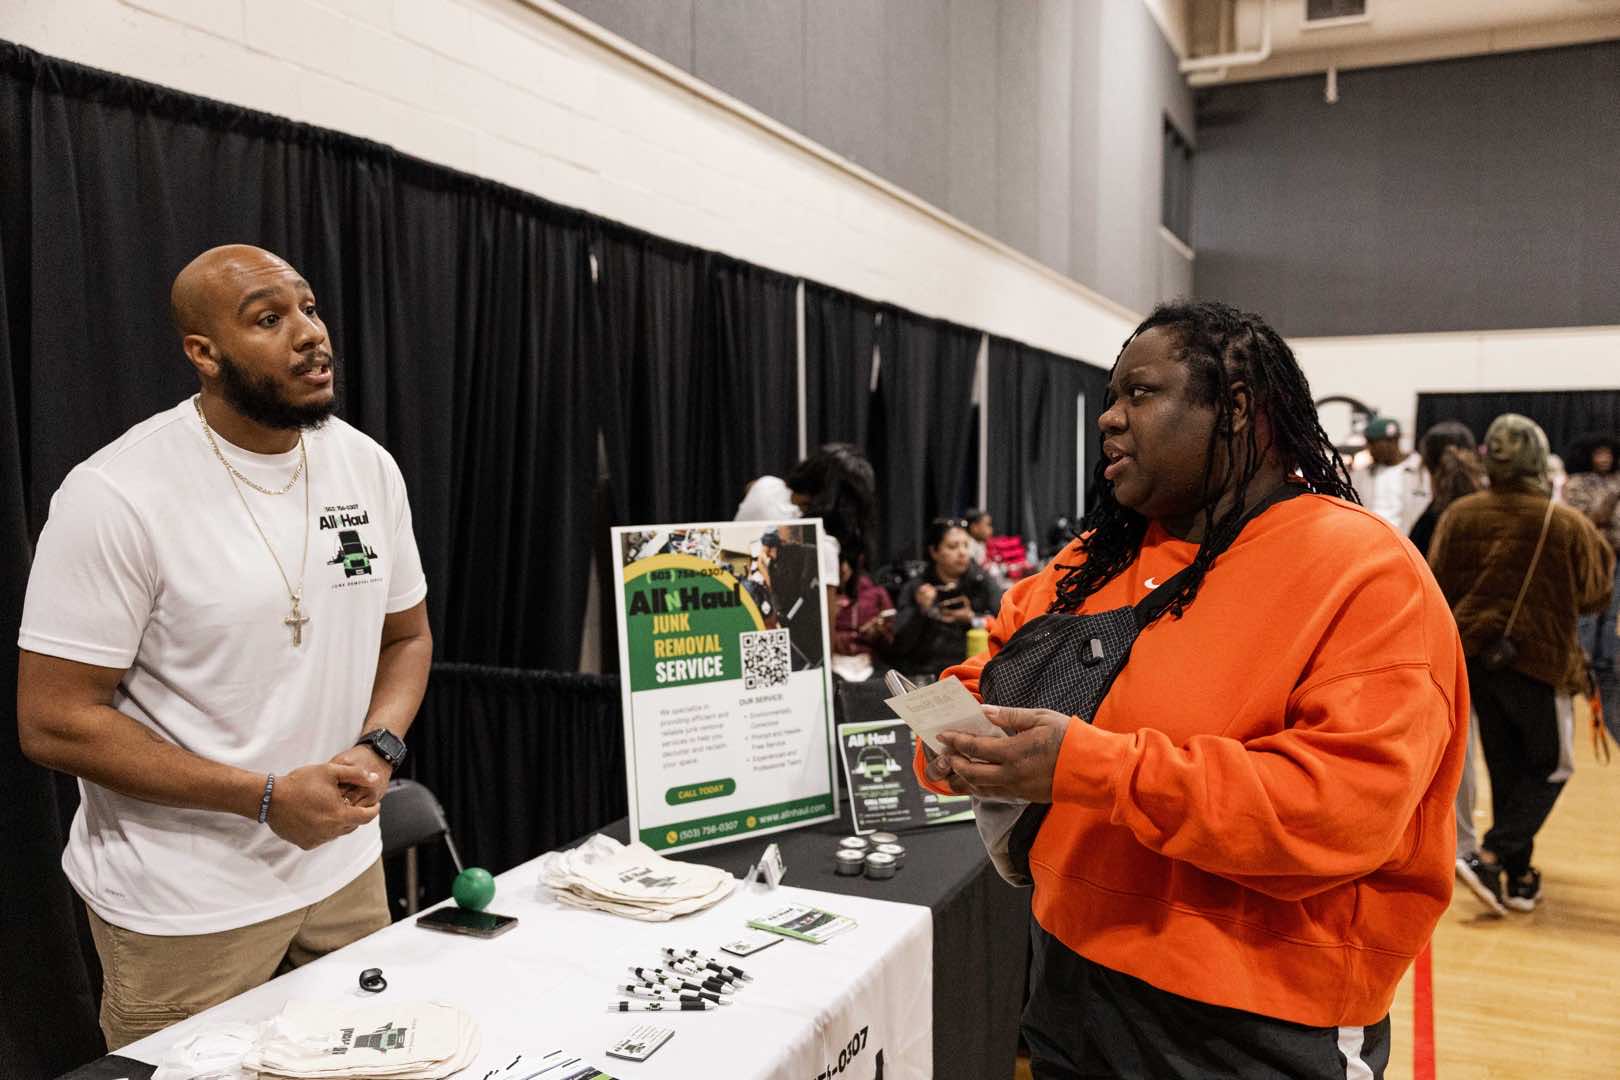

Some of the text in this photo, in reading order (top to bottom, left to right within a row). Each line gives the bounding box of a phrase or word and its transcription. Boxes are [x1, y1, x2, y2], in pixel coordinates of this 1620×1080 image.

[653, 613, 690, 634] JUNK
[654, 635, 722, 658] REMOVAL
[655, 656, 724, 683] SERVICE
[678, 784, 725, 800] CALL TODAY
[679, 831, 701, 841] (503)
